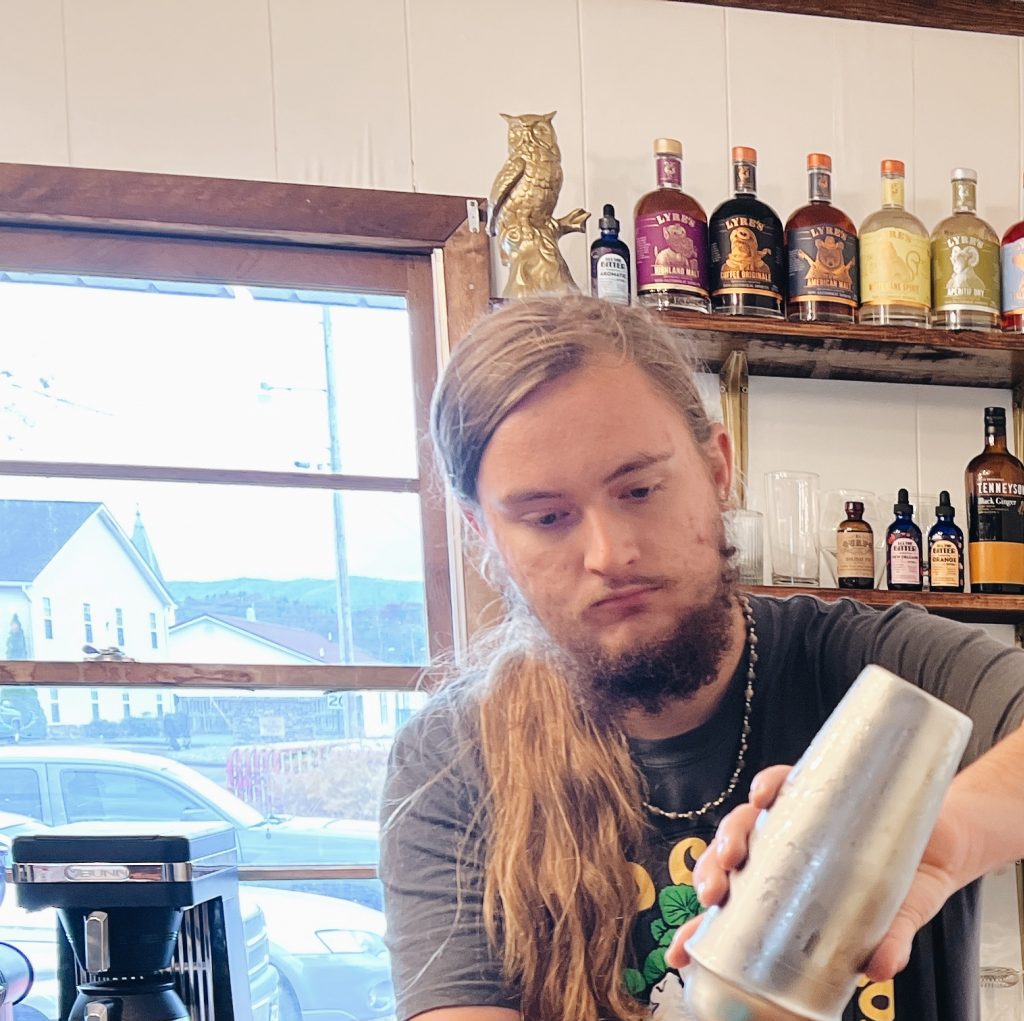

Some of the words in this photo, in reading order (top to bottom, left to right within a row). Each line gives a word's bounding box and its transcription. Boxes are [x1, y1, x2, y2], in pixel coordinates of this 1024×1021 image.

[656, 212, 696, 228] LYRE'S
[725, 217, 765, 231] LYRE'S
[79, 868, 128, 877] BUNN
